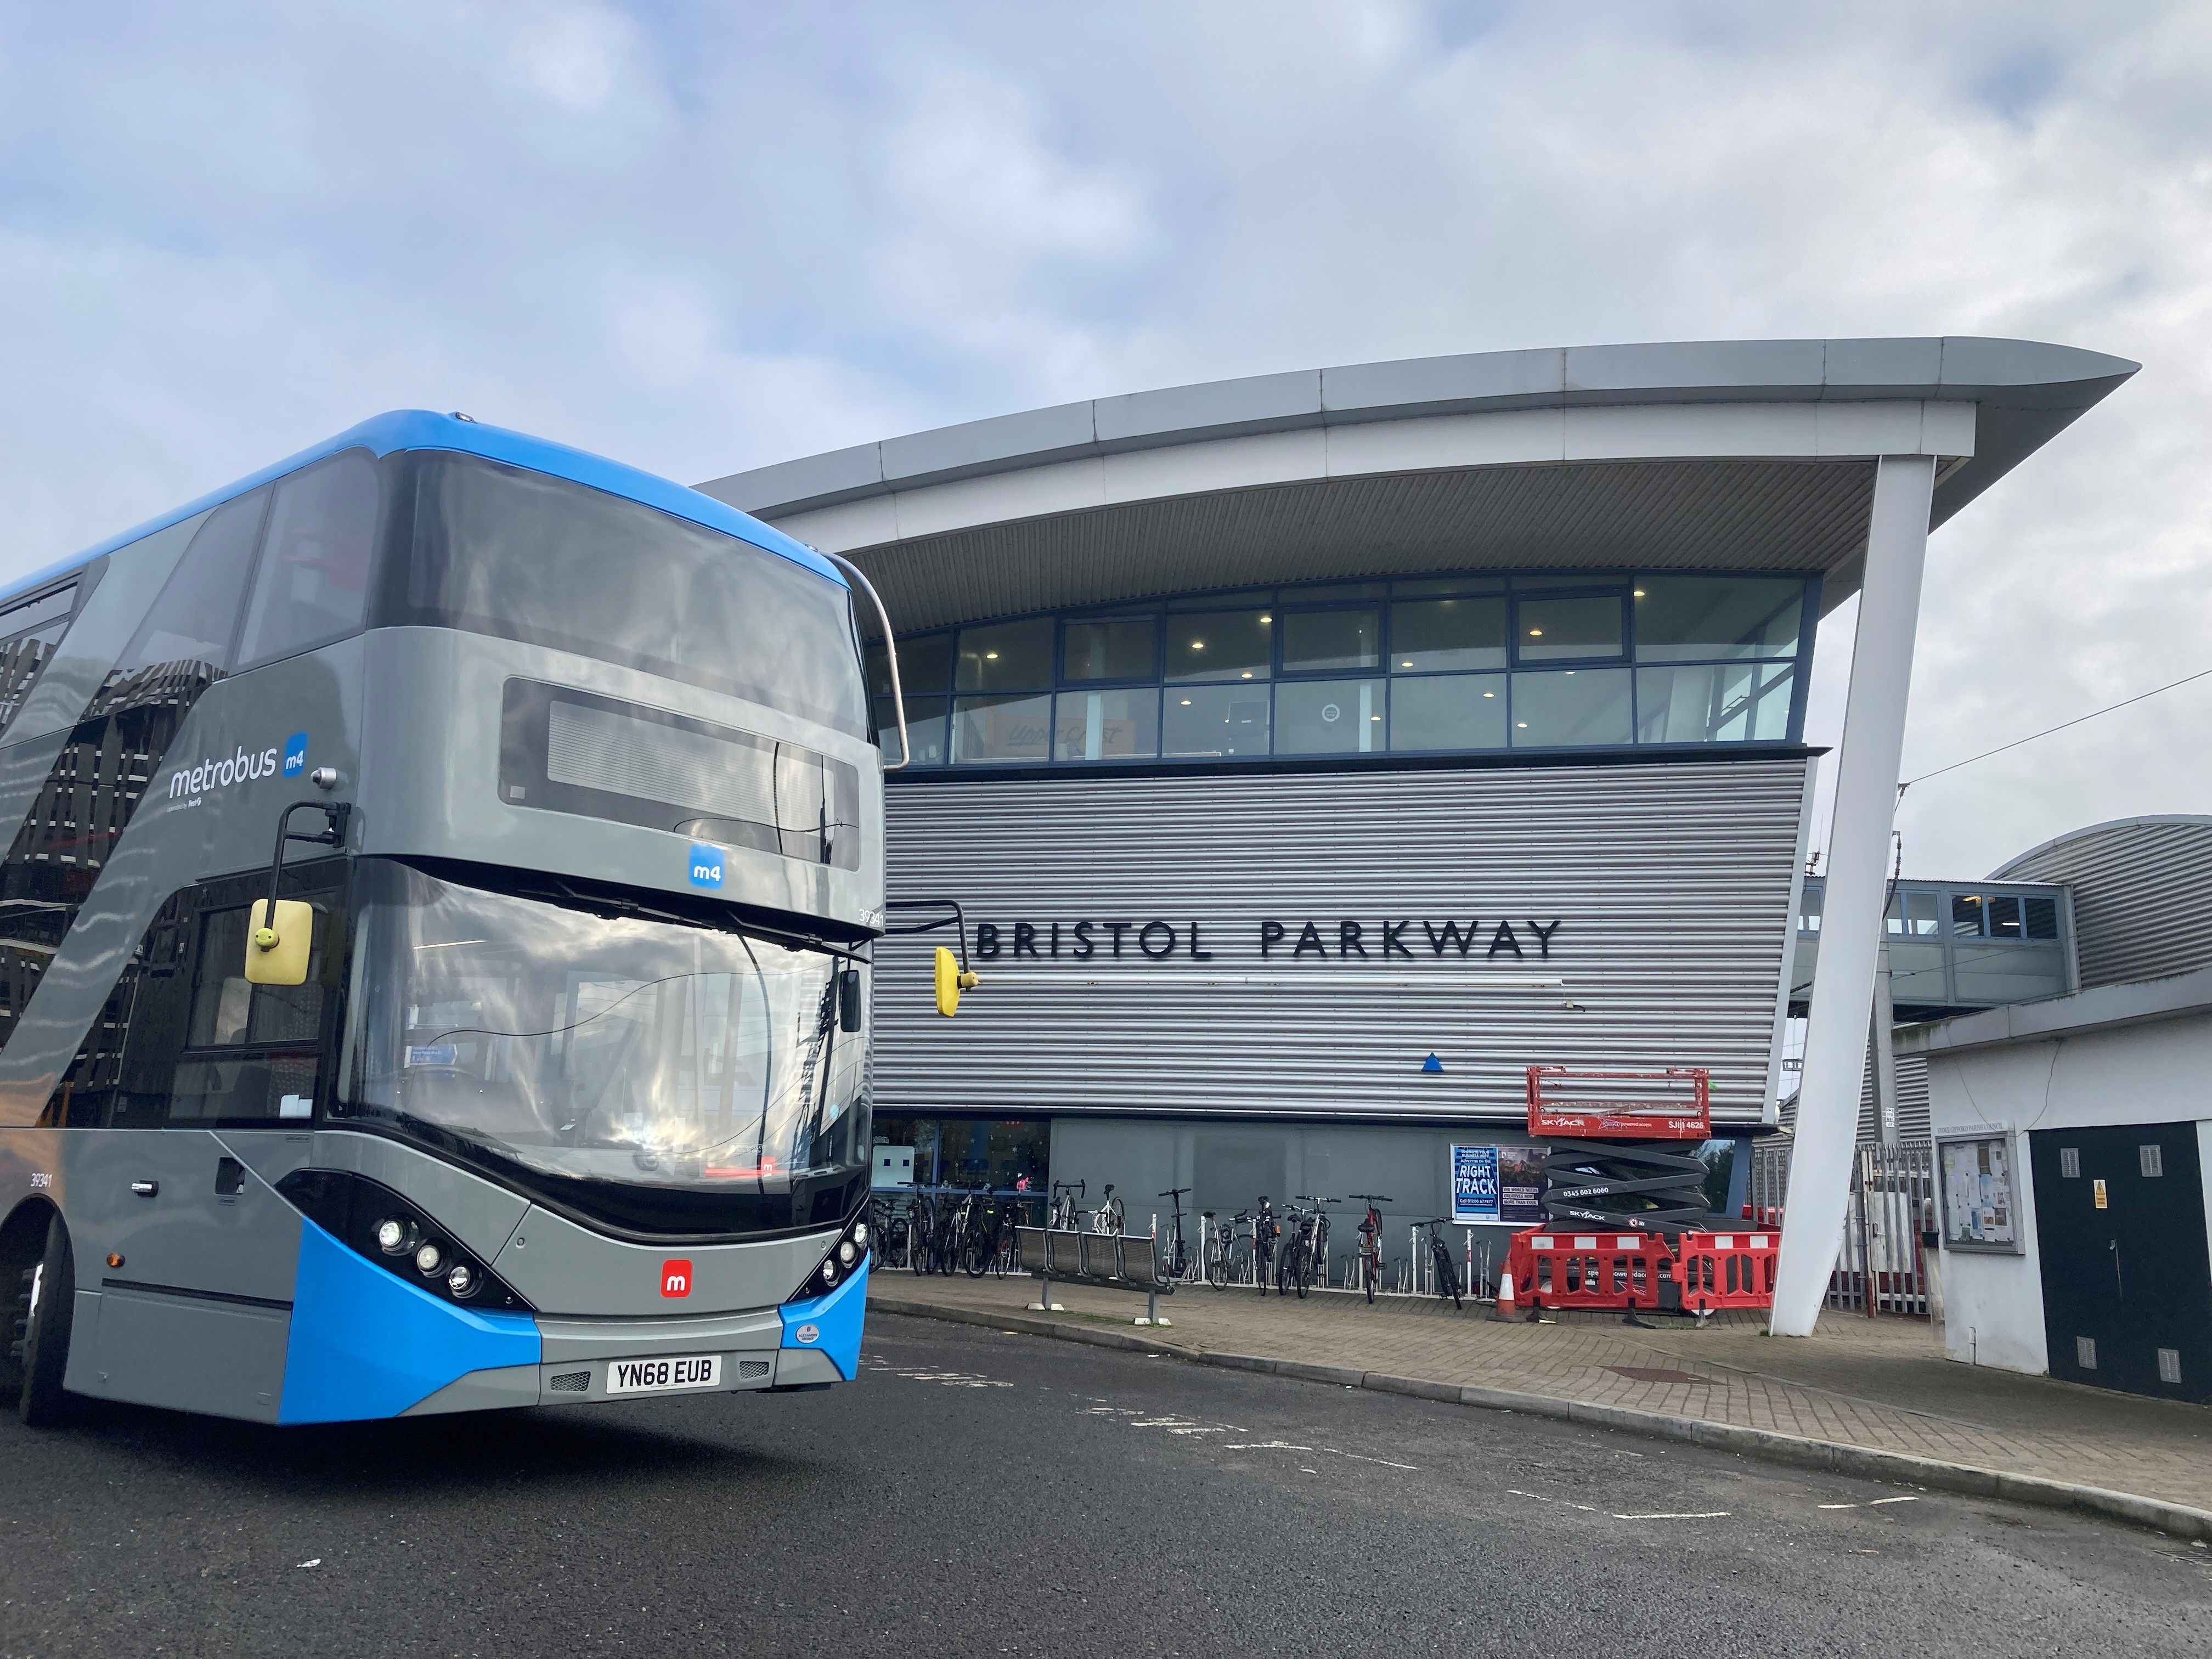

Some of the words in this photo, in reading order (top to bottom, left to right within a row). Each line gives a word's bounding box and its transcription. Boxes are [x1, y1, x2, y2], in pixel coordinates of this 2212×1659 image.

[1008, 724, 1065, 744] Uppr
[285, 750, 304, 770] m4
[169, 746, 278, 799] metrobus
[693, 865, 721, 882] m4
[859, 908, 883, 927] 39341
[976, 921, 1212, 958] BRISTOL
[1261, 920, 1561, 958] PARKWAY
[1984, 1122, 2004, 1131] COUNCIL
[1459, 1165, 1491, 1178] RIGHT
[30, 1173, 53, 1188] 39341
[1456, 1178, 1497, 1194] TRACK
[1569, 1210, 1605, 1221] SKYJACK
[666, 1276, 685, 1291] m
[618, 1362, 669, 1387] YN68
[674, 1359, 712, 1384] EUB
